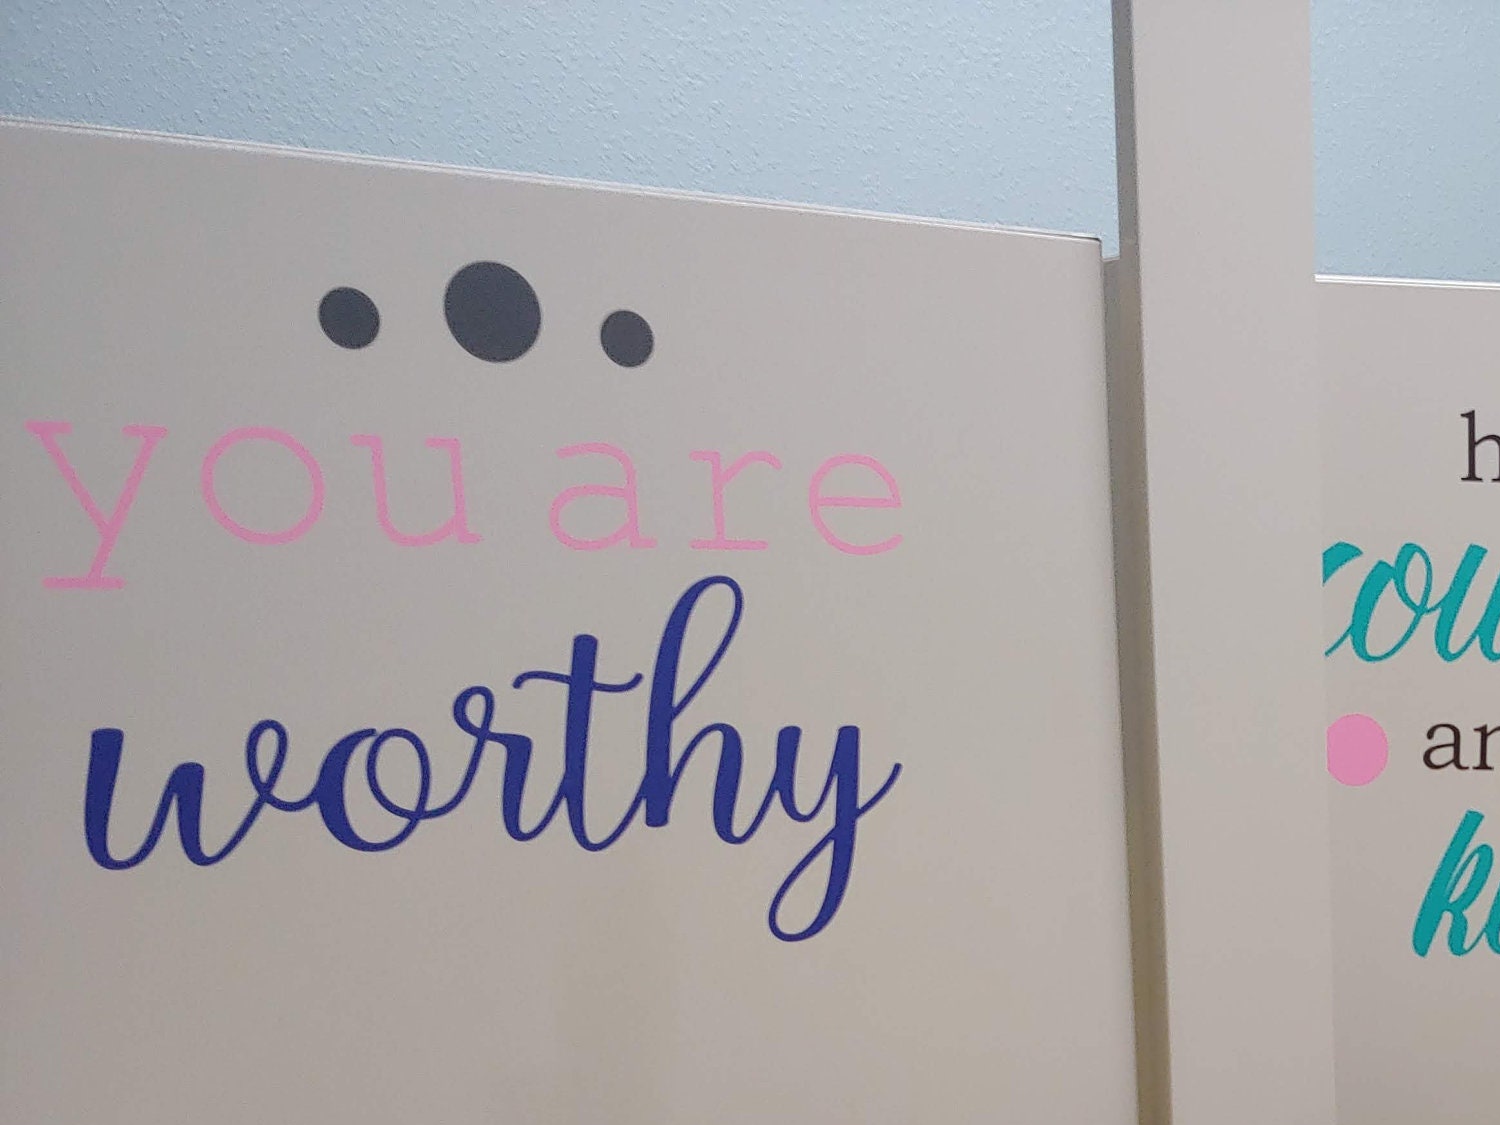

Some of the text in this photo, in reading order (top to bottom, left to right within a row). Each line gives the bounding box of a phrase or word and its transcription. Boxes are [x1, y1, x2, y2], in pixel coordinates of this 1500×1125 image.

[25, 420, 904, 590] you are
[83, 575, 902, 943] worthy
